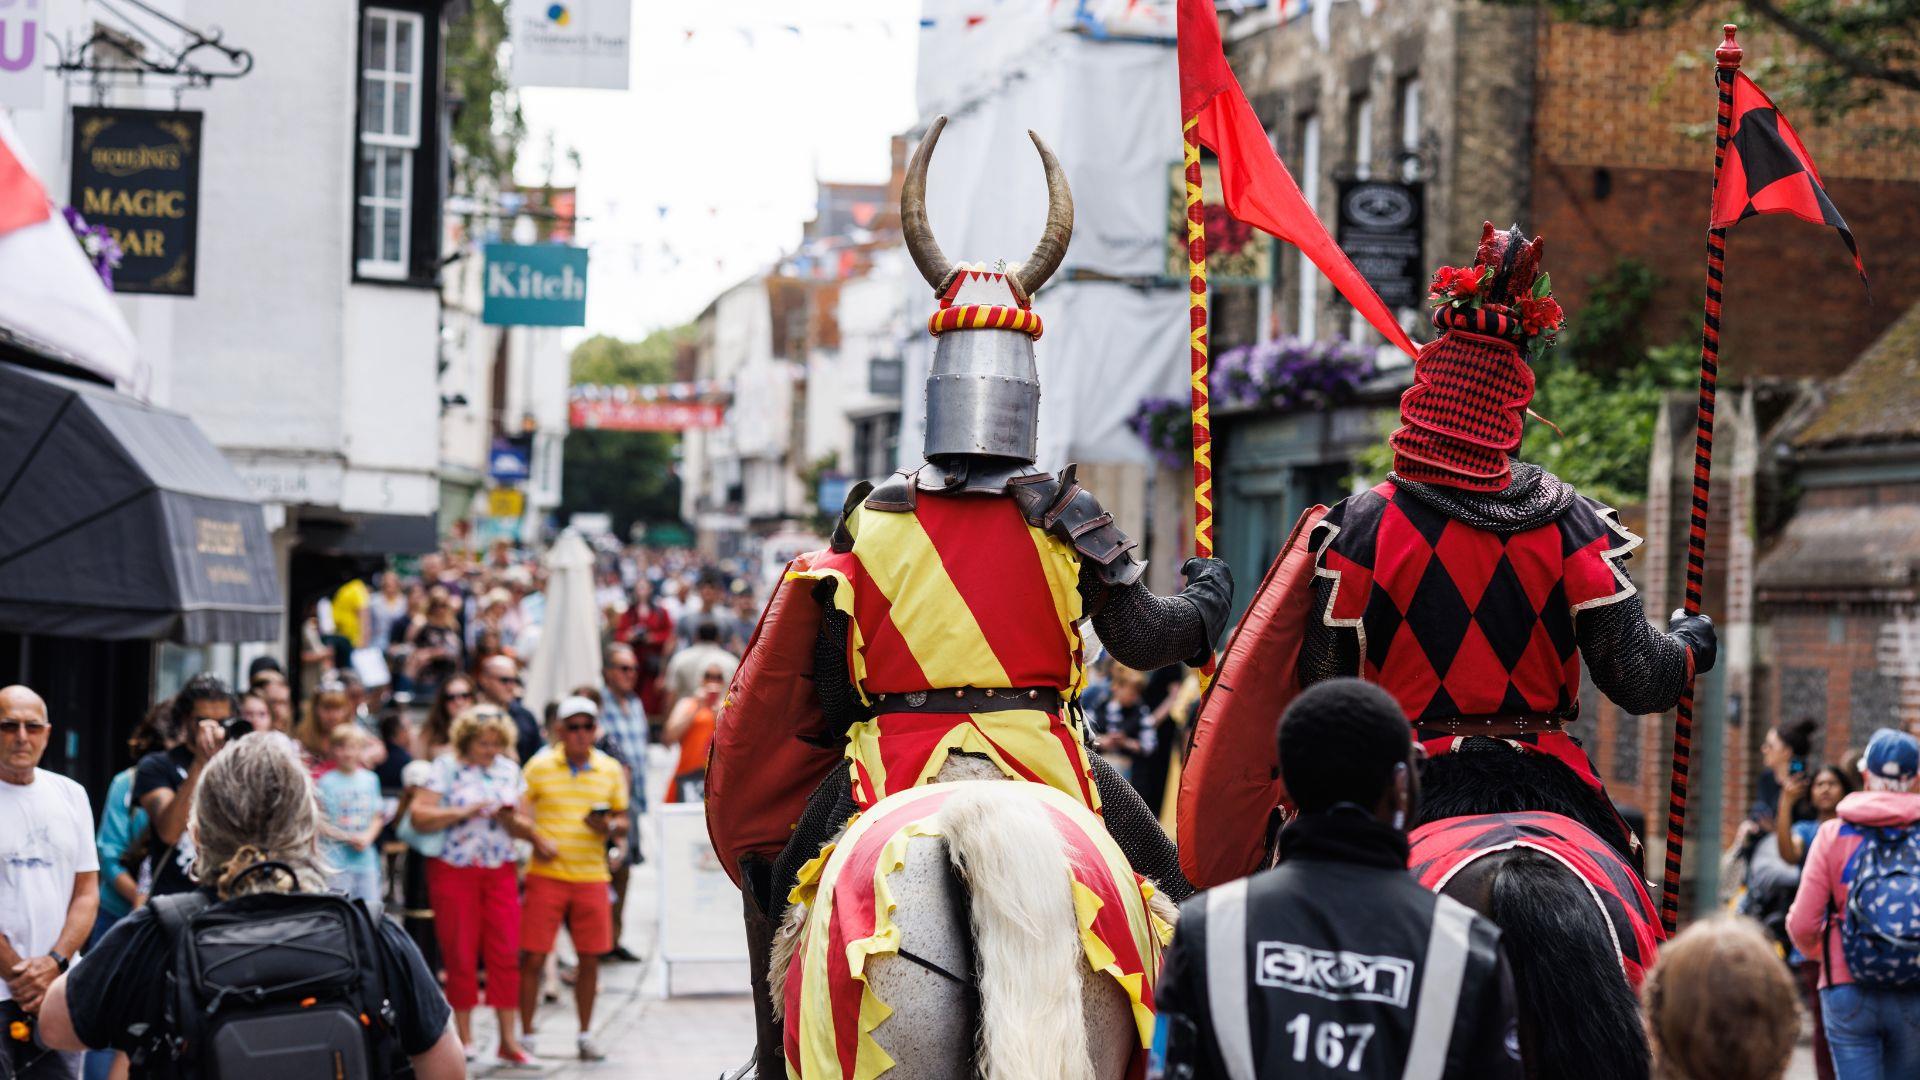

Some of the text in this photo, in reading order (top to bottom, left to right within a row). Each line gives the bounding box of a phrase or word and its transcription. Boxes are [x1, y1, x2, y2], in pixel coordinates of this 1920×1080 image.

[82, 186, 186, 219] MAGIC
[488, 261, 585, 300] Kitch
[1285, 1013, 1376, 1072] 167
